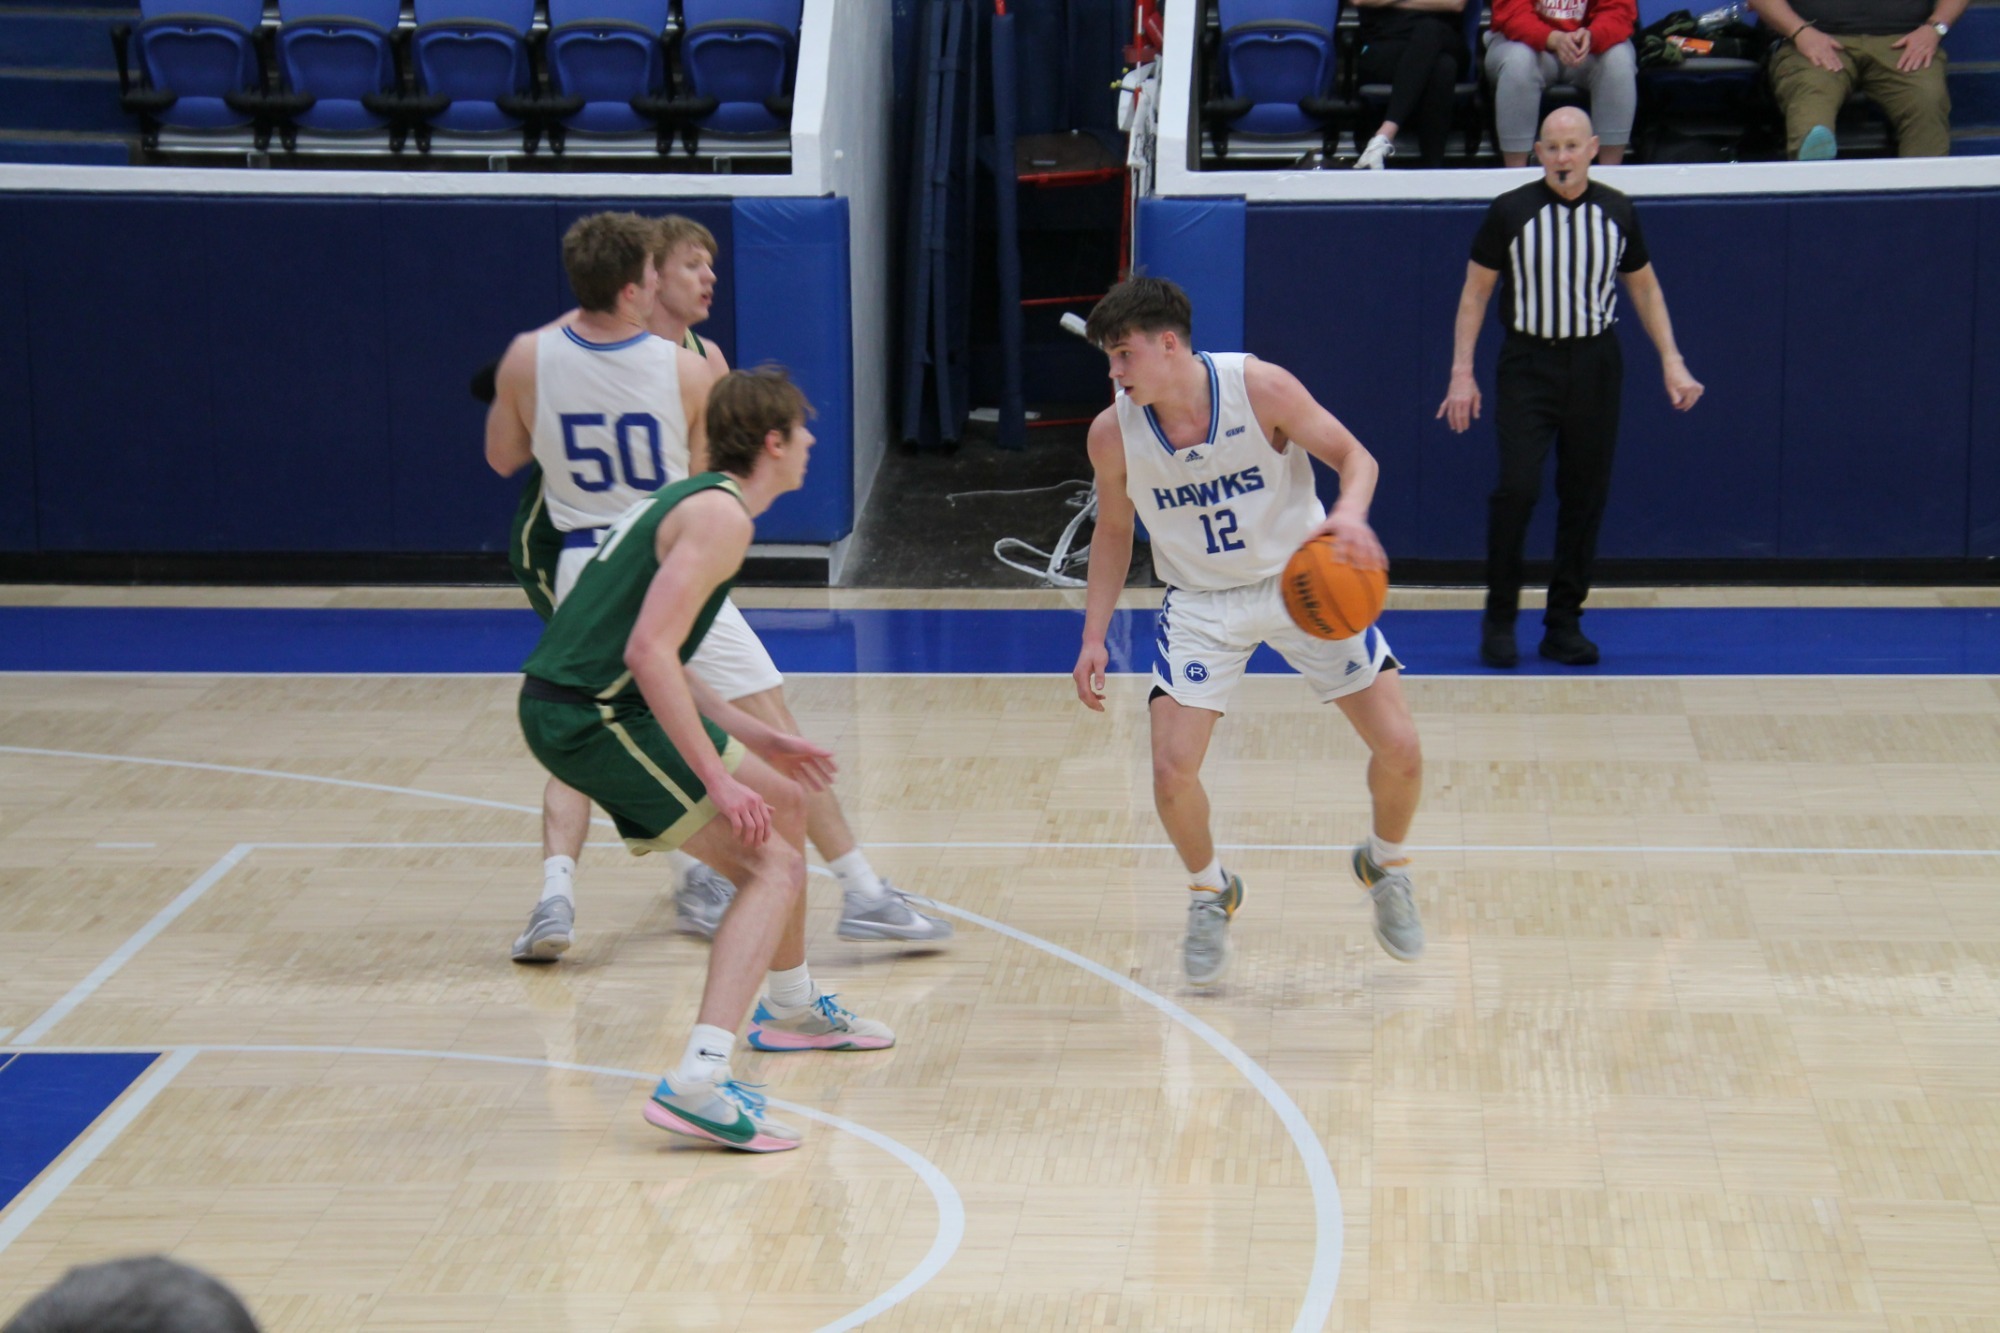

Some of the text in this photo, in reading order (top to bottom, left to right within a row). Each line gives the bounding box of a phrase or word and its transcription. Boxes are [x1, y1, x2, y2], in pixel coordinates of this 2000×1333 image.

[560, 412, 666, 493] 50
[1152, 465, 1265, 510] HAWKS
[1199, 508, 1246, 554] 12
